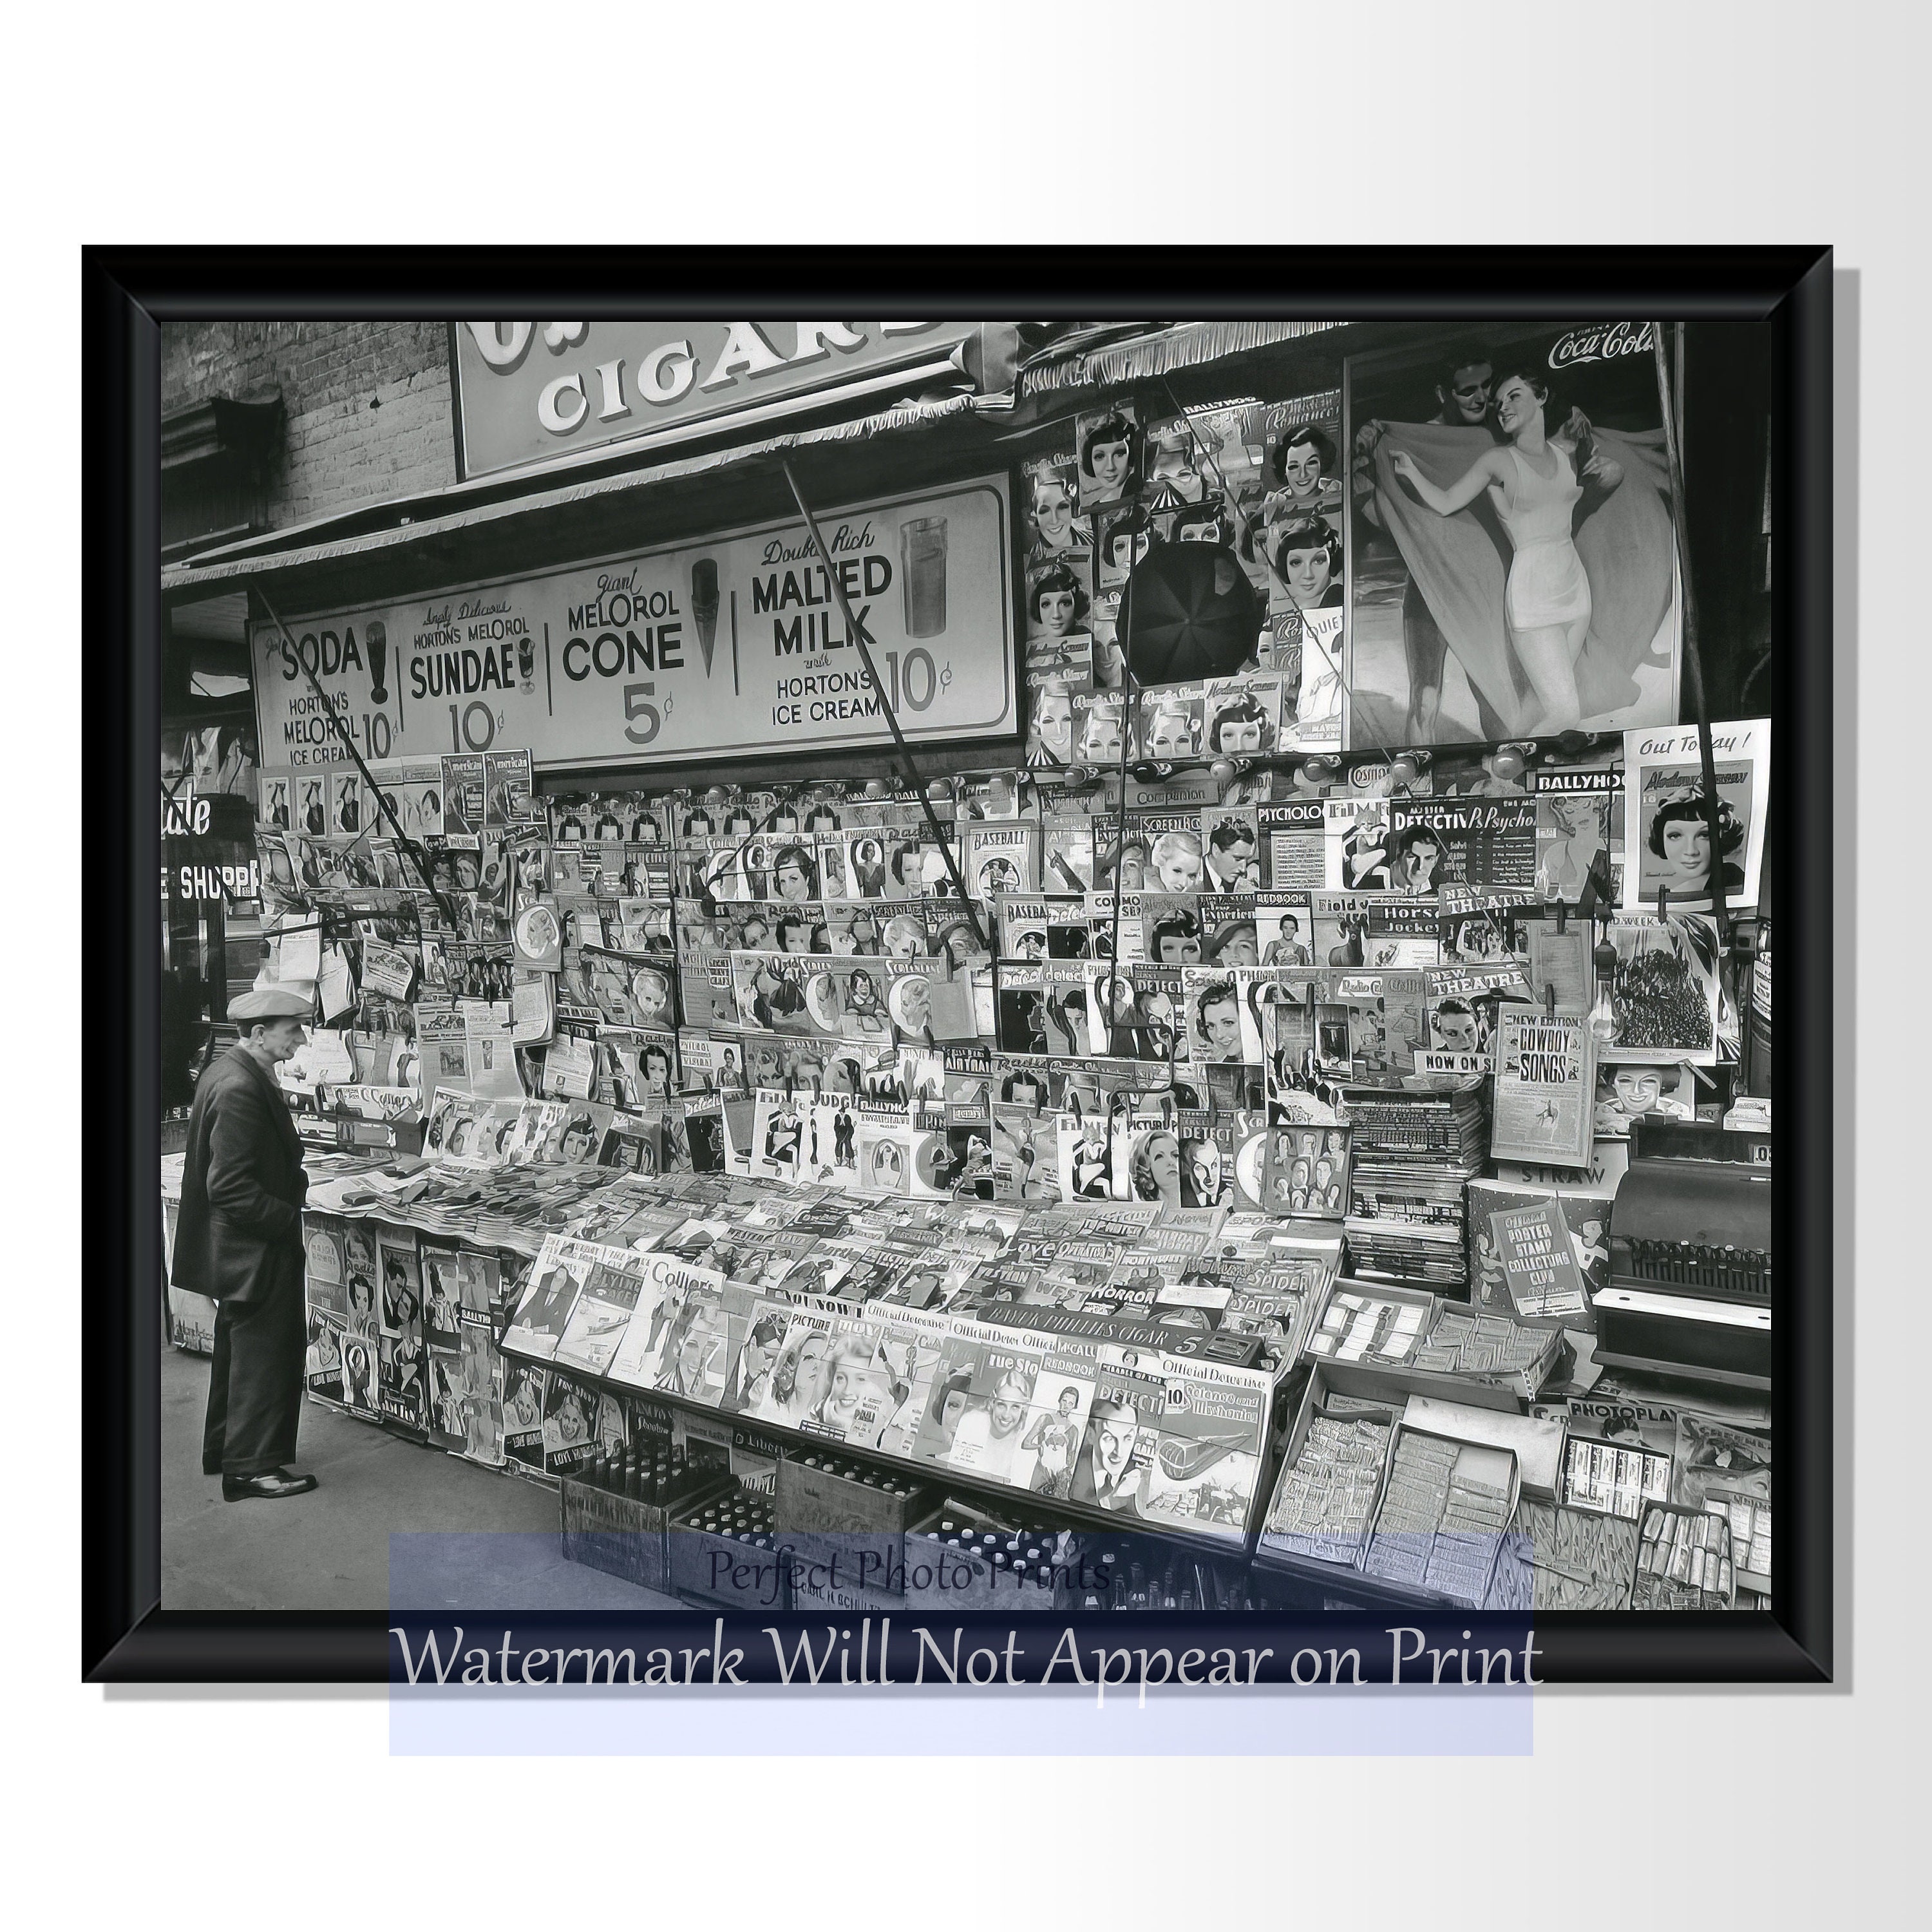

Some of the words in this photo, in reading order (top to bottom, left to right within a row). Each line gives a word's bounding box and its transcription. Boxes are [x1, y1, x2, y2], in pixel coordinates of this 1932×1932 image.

[538, 322, 944, 435] CIGAR
[831, 520, 875, 554] Rich
[752, 555, 893, 614] MALTED
[568, 591, 680, 632] MELOROL
[468, 617, 529, 642] MELOROL
[773, 604, 877, 656] MILK
[281, 626, 364, 681] SODA
[563, 623, 685, 681] CONE
[410, 643, 515, 699] SUNDAE
[777, 669, 874, 698] HORTON'S
[772, 706, 802, 725] ICE
[810, 697, 880, 722] CREAM
[290, 750, 308, 766] ICE
[1640, 738, 1676, 755] Out
[1539, 775, 1625, 790] BALLYHO
[1482, 806, 1536, 834] Psycho
[1432, 972, 1526, 996] THEATRE
[1520, 1030, 1570, 1051] COWBOY
[1426, 1056, 1455, 1069] NOW
[1461, 1057, 1477, 1070] ON
[1520, 1054, 1566, 1083] SONGS
[1119, 1325, 1170, 1347] CIGAR
[1168, 1389, 1183, 1405] 10
